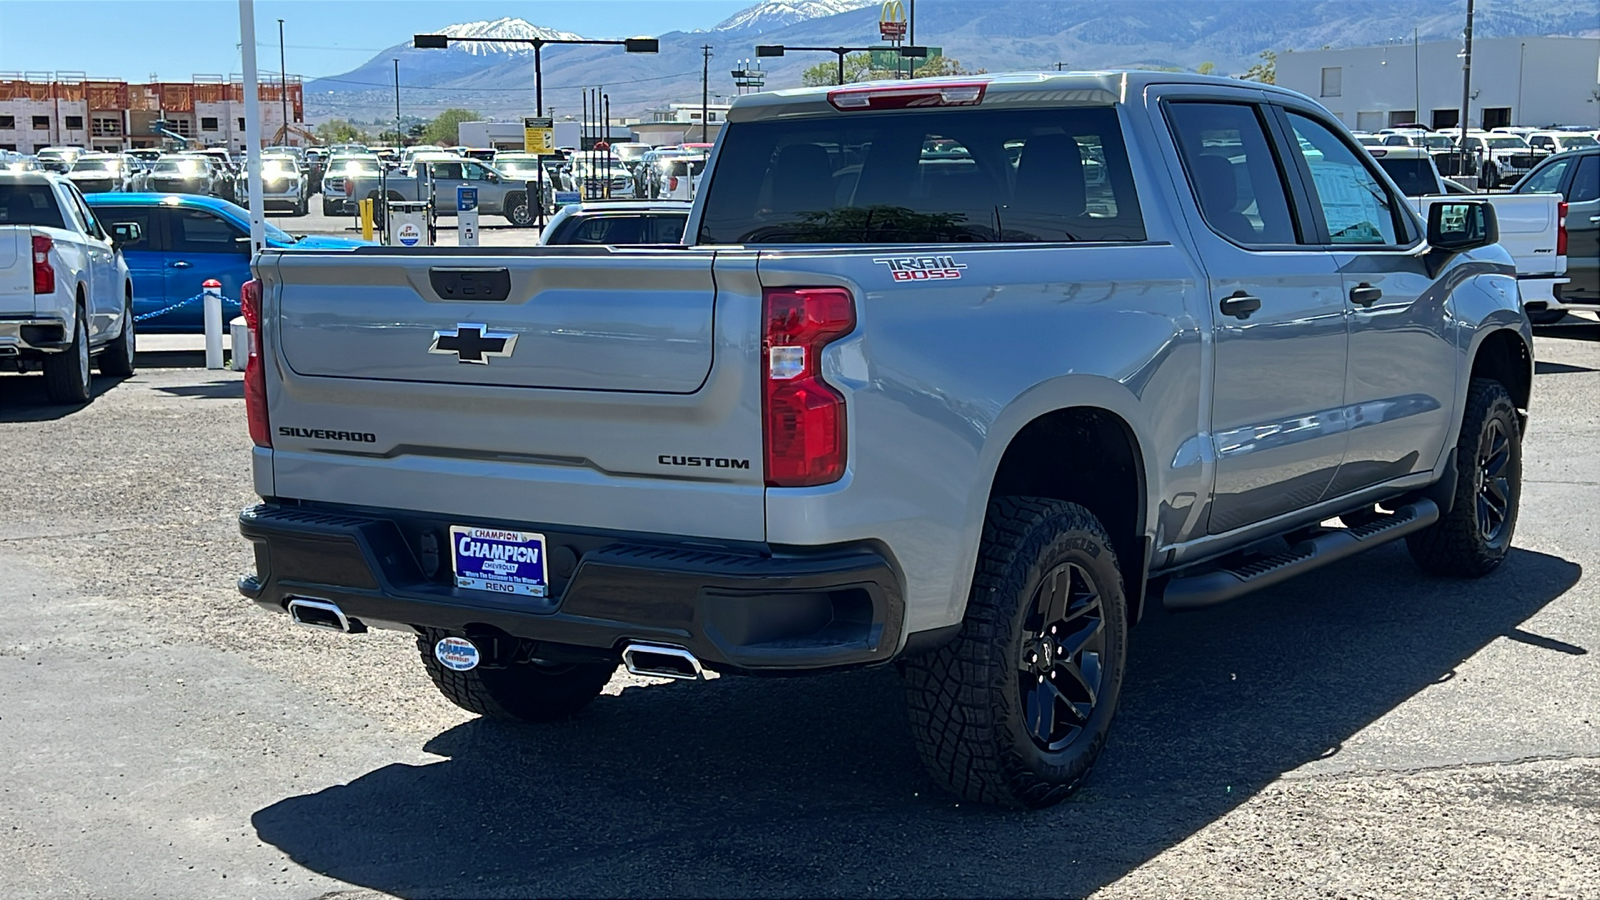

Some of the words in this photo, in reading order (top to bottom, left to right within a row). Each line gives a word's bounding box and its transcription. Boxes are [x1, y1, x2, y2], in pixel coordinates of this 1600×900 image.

[873, 256, 968, 271] TRAIL
[893, 268, 961, 282] BOSS
[279, 426, 377, 443] SILVERADO
[658, 455, 750, 469] CUSTOM
[474, 529, 519, 541] CHAMPION
[459, 537, 539, 564] CHAMPION
[484, 562, 516, 571] CHEVROLET
[485, 582, 515, 593] RENO
